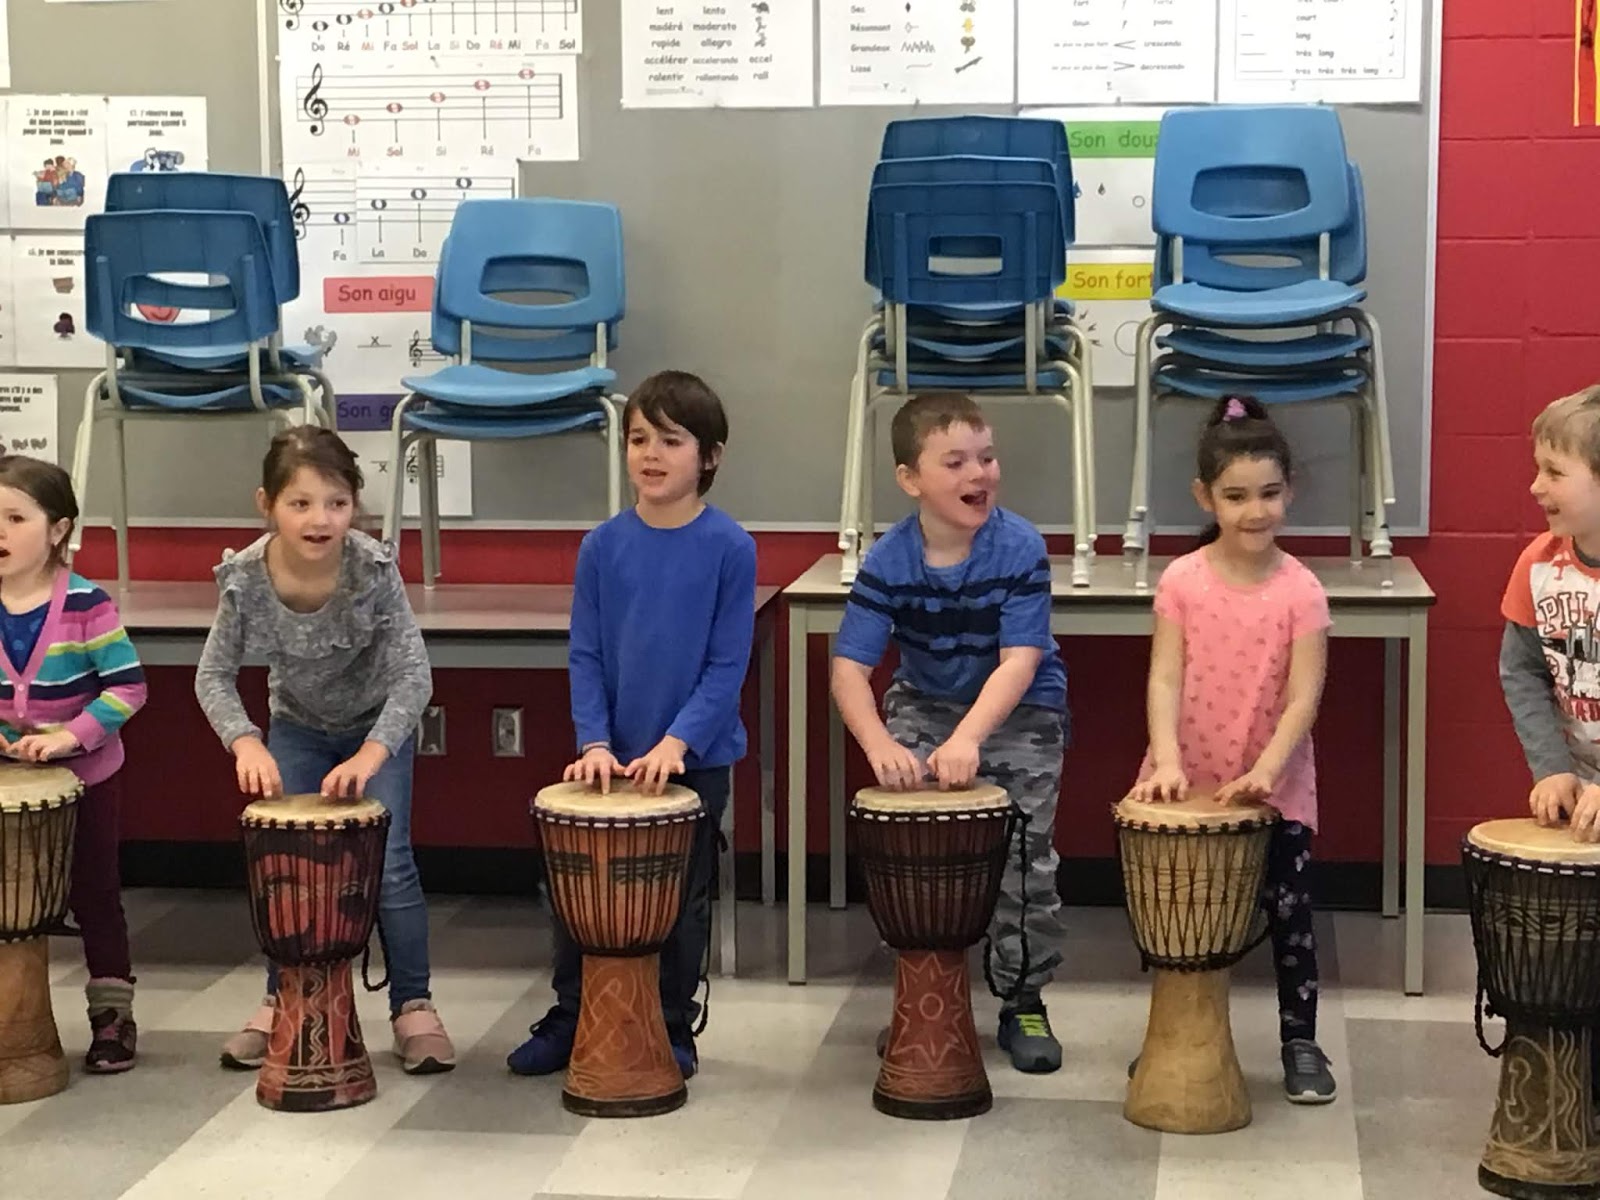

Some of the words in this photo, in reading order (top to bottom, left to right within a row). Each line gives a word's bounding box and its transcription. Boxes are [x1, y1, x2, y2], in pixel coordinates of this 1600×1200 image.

[656, 7, 674, 15] lent
[703, 6, 726, 15] lento
[693, 22, 736, 31] moderato
[311, 40, 325, 52] Do
[337, 41, 350, 51] Ré
[361, 42, 374, 51] Mi
[384, 41, 397, 51] Fa
[402, 40, 418, 51] Sol
[428, 40, 440, 51] La
[466, 40, 480, 50] Do
[490, 40, 503, 50] Ré
[508, 40, 521, 49] Mi
[559, 39, 575, 50] Sol
[701, 38, 732, 49] allegro
[644, 55, 688, 64] accélérer
[749, 54, 772, 63] accel
[1319, 50, 1334, 58] long
[1071, 131, 1106, 149] Son
[347, 148, 360, 157] Mi
[386, 146, 403, 157] Sol
[436, 146, 447, 156] Si
[481, 145, 494, 156] Ré
[528, 144, 541, 156] Fa
[333, 250, 347, 261] Fa
[372, 248, 385, 258] La
[413, 248, 427, 258] Do
[1074, 271, 1109, 288] Son
[1113, 271, 1153, 289] fort
[338, 285, 373, 302] Son
[378, 285, 415, 306] aigu
[338, 401, 372, 418] Son
